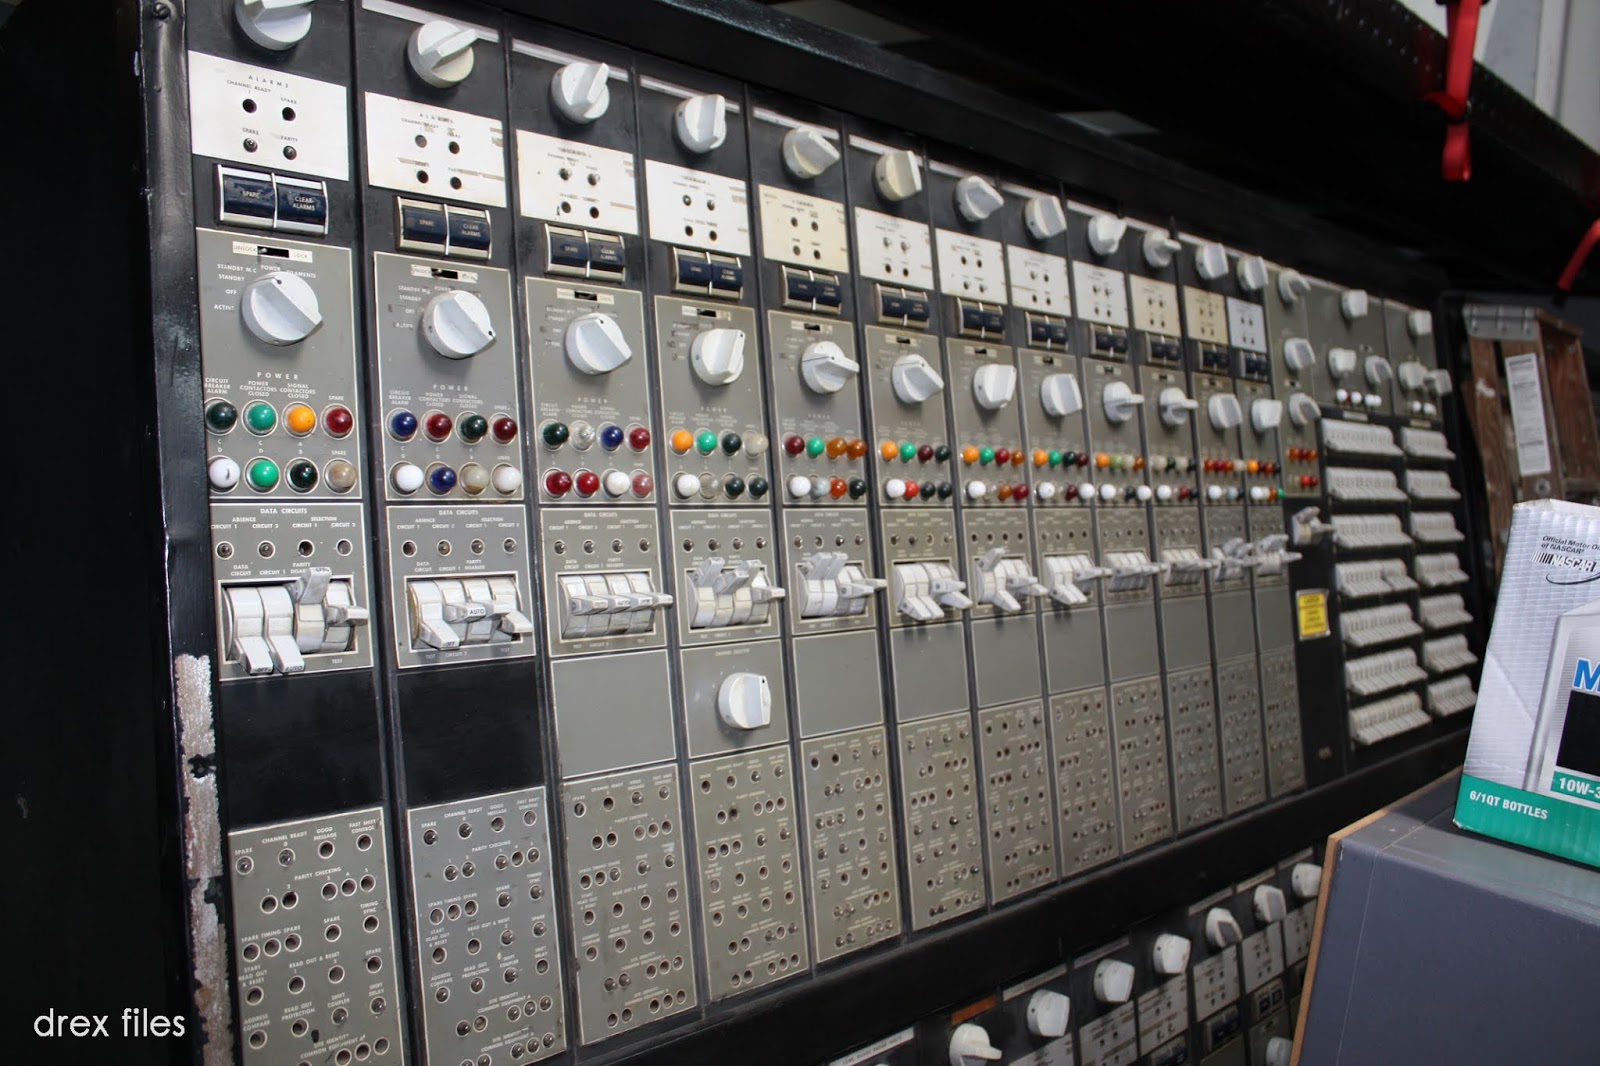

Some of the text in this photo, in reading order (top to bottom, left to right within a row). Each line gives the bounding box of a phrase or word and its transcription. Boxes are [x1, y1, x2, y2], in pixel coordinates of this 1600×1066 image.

[227, 80, 252, 90] CHANNEL
[248, 75, 288, 88] ALARMS
[242, 190, 260, 199] SPARE
[292, 203, 316, 211] ALARMS
[217, 264, 243, 272] STANDBY
[257, 372, 298, 380] POWER
[1542, 536, 1567, 545] Official
[1568, 540, 1590, 548] Motor
[1550, 554, 1596, 572] NASCAR
[1469, 790, 1548, 820] 6/1QT BOTTLES
[351, 826, 375, 834] CONTROL
[262, 831, 308, 844] CHANNEL READY
[314, 832, 337, 841] MESSAGE
[294, 867, 342, 881] PARITY CHECKING
[324, 916, 340, 924] SPARE
[241, 925, 301, 942] SPARE TIMING SPARE
[325, 952, 340, 960] RESET
[239, 973, 253, 981] READ
[369, 988, 384, 996] DELAY
[328, 998, 350, 1008] COUPLER
[282, 1008, 315, 1021] PROTECTION
[284, 1006, 299, 1014] READ
[244, 1014, 269, 1024] ADDRESS
[243, 1020, 270, 1032] COMPARE
